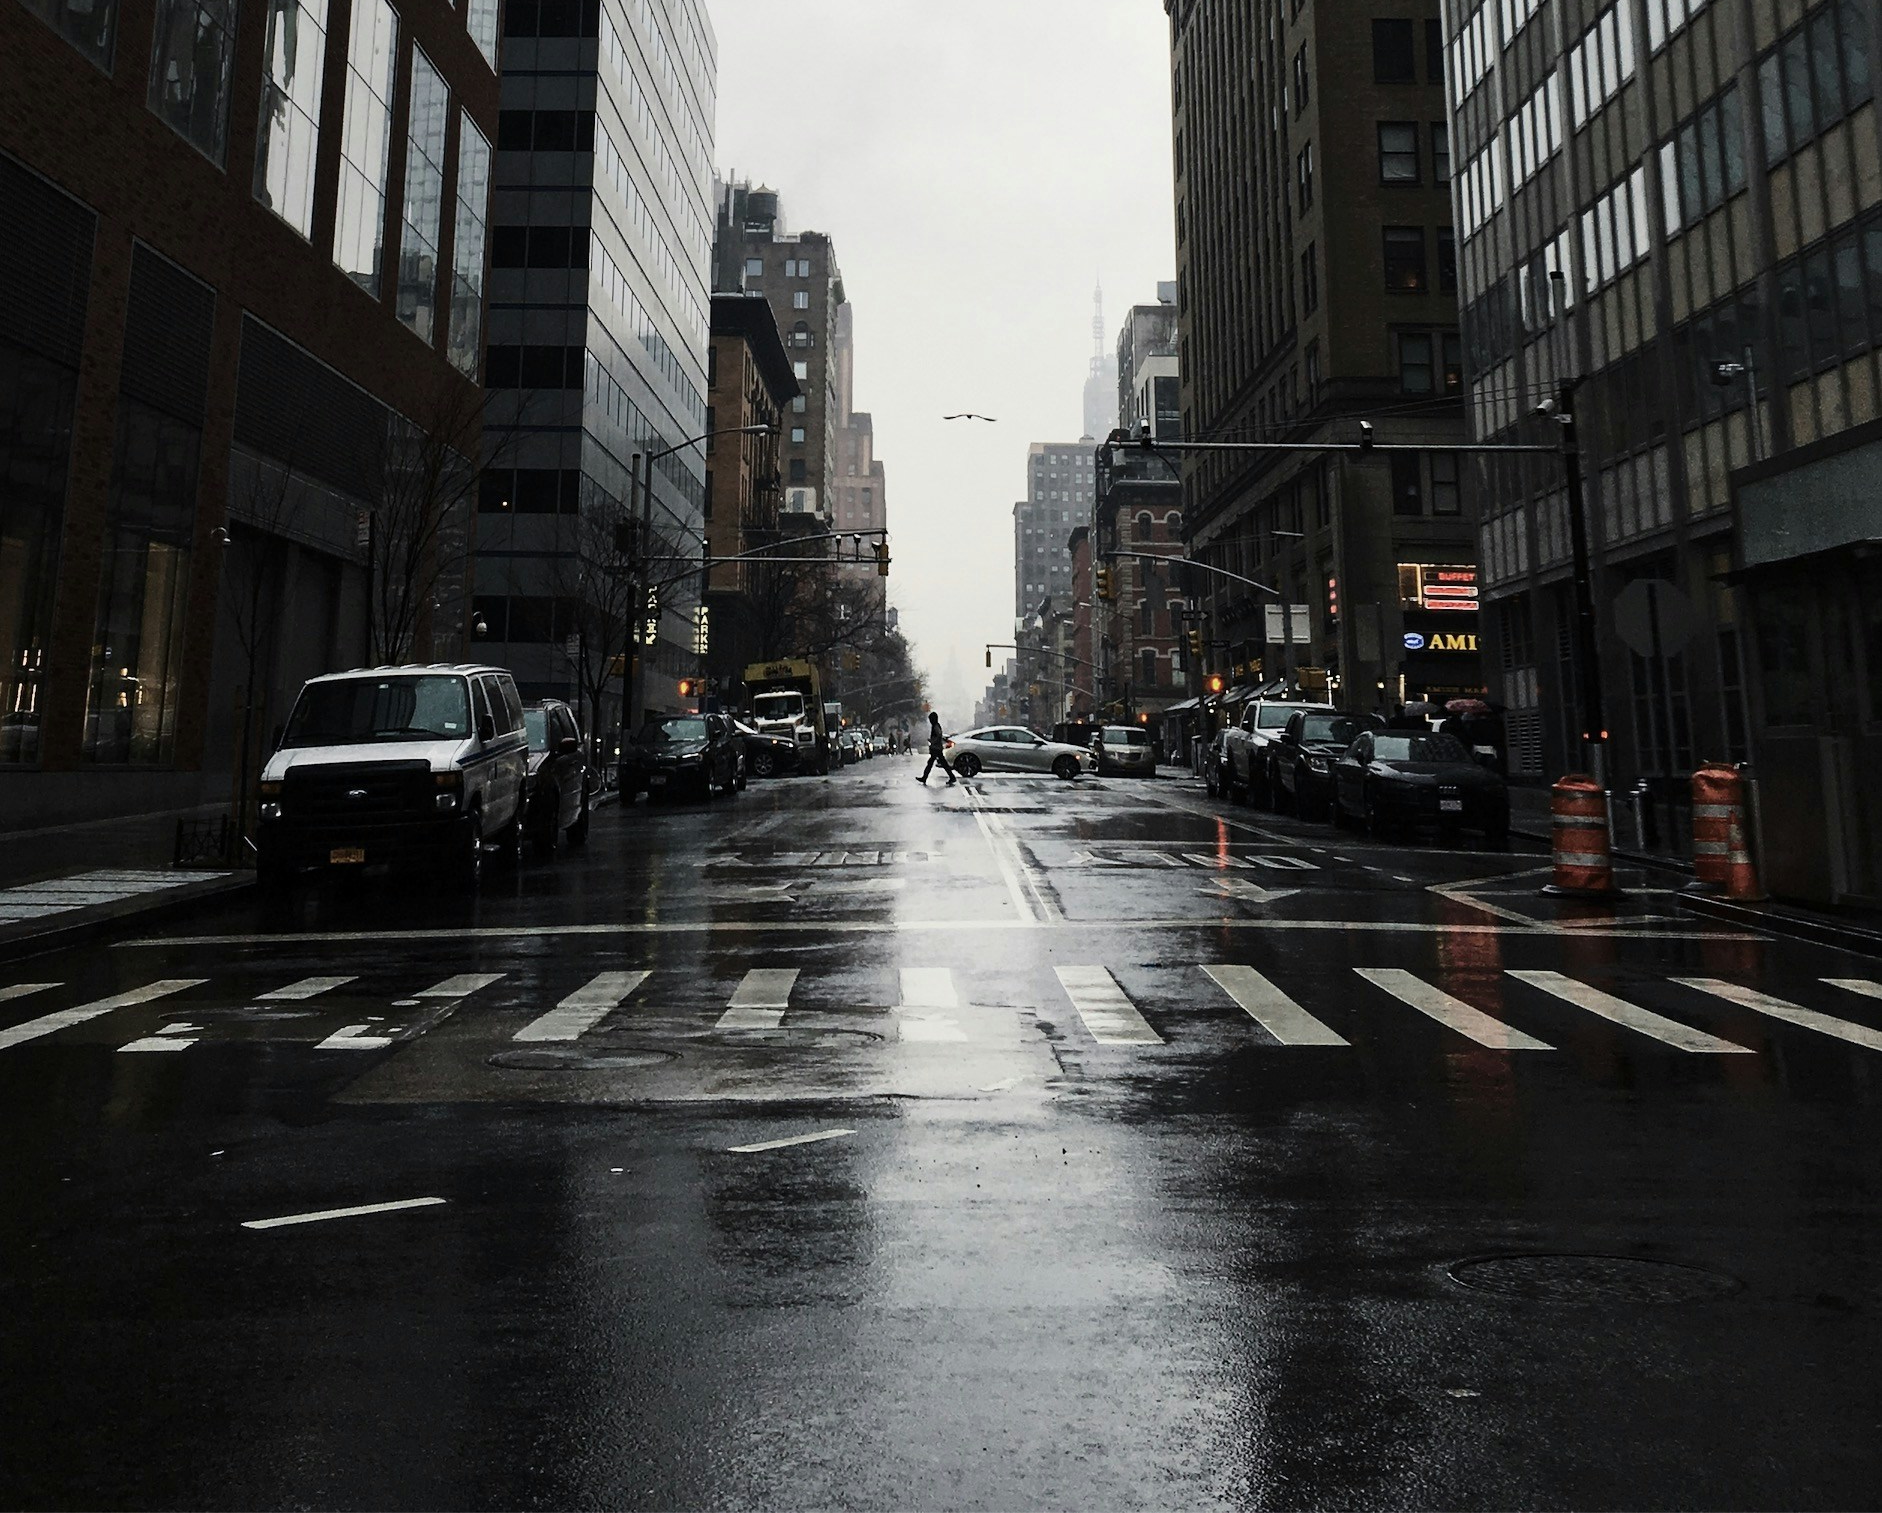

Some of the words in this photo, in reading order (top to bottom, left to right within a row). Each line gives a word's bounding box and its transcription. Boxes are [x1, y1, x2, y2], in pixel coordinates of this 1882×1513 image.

[1438, 572, 1475, 581] BUFFET
[1428, 633, 1480, 651] AMI
[1068, 850, 1321, 870] ONLY
